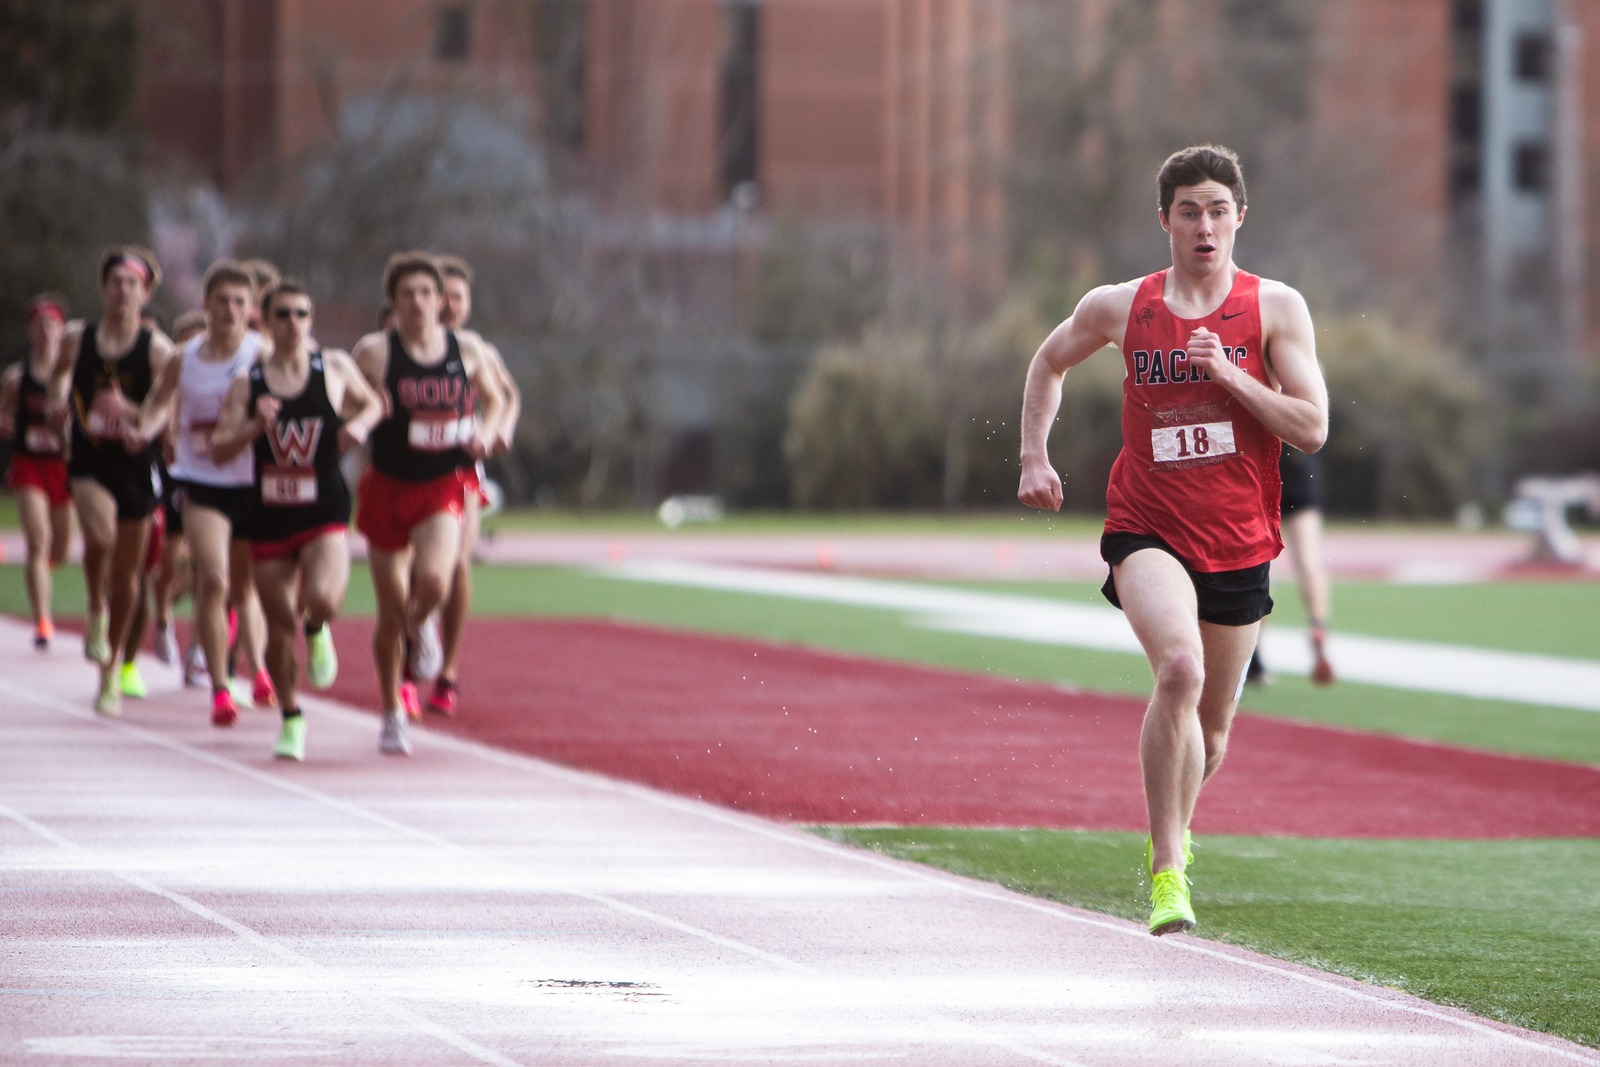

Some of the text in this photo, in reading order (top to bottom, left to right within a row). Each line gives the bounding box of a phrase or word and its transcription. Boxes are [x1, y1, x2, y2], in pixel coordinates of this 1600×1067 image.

[1133, 346, 1248, 385] PACIC
[265, 416, 323, 466] W
[1176, 427, 1209, 457] 18
